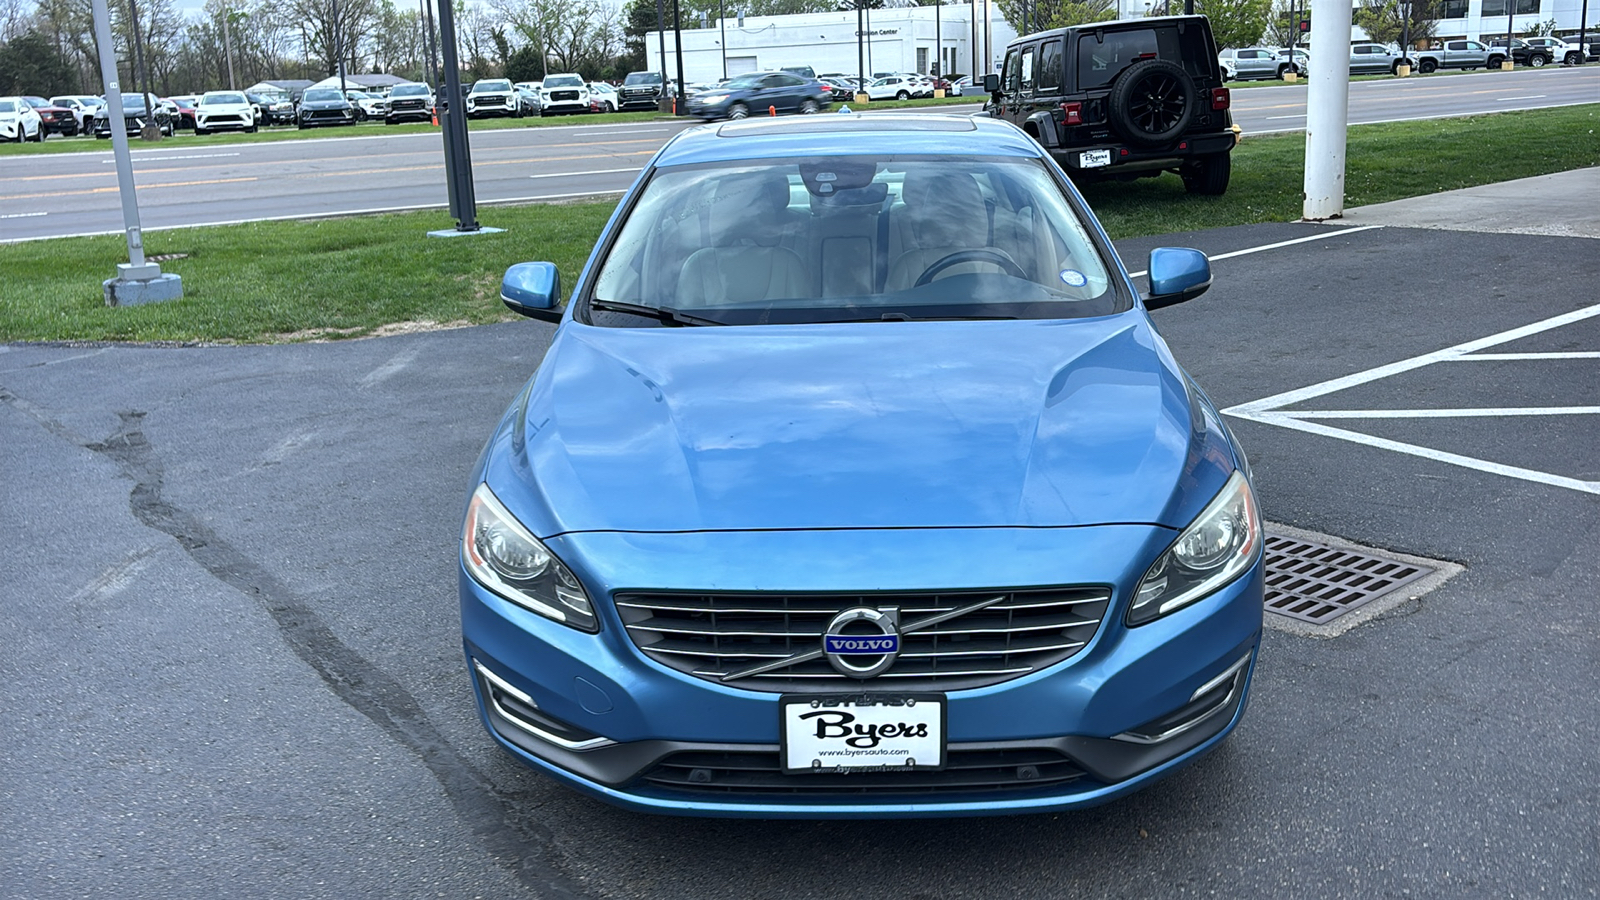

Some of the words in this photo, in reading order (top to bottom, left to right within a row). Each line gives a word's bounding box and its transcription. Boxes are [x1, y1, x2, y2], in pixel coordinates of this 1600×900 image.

[830, 639, 893, 650] VOLVO
[798, 710, 928, 749] Byers
[818, 748, 909, 757] www.byersauto.com
